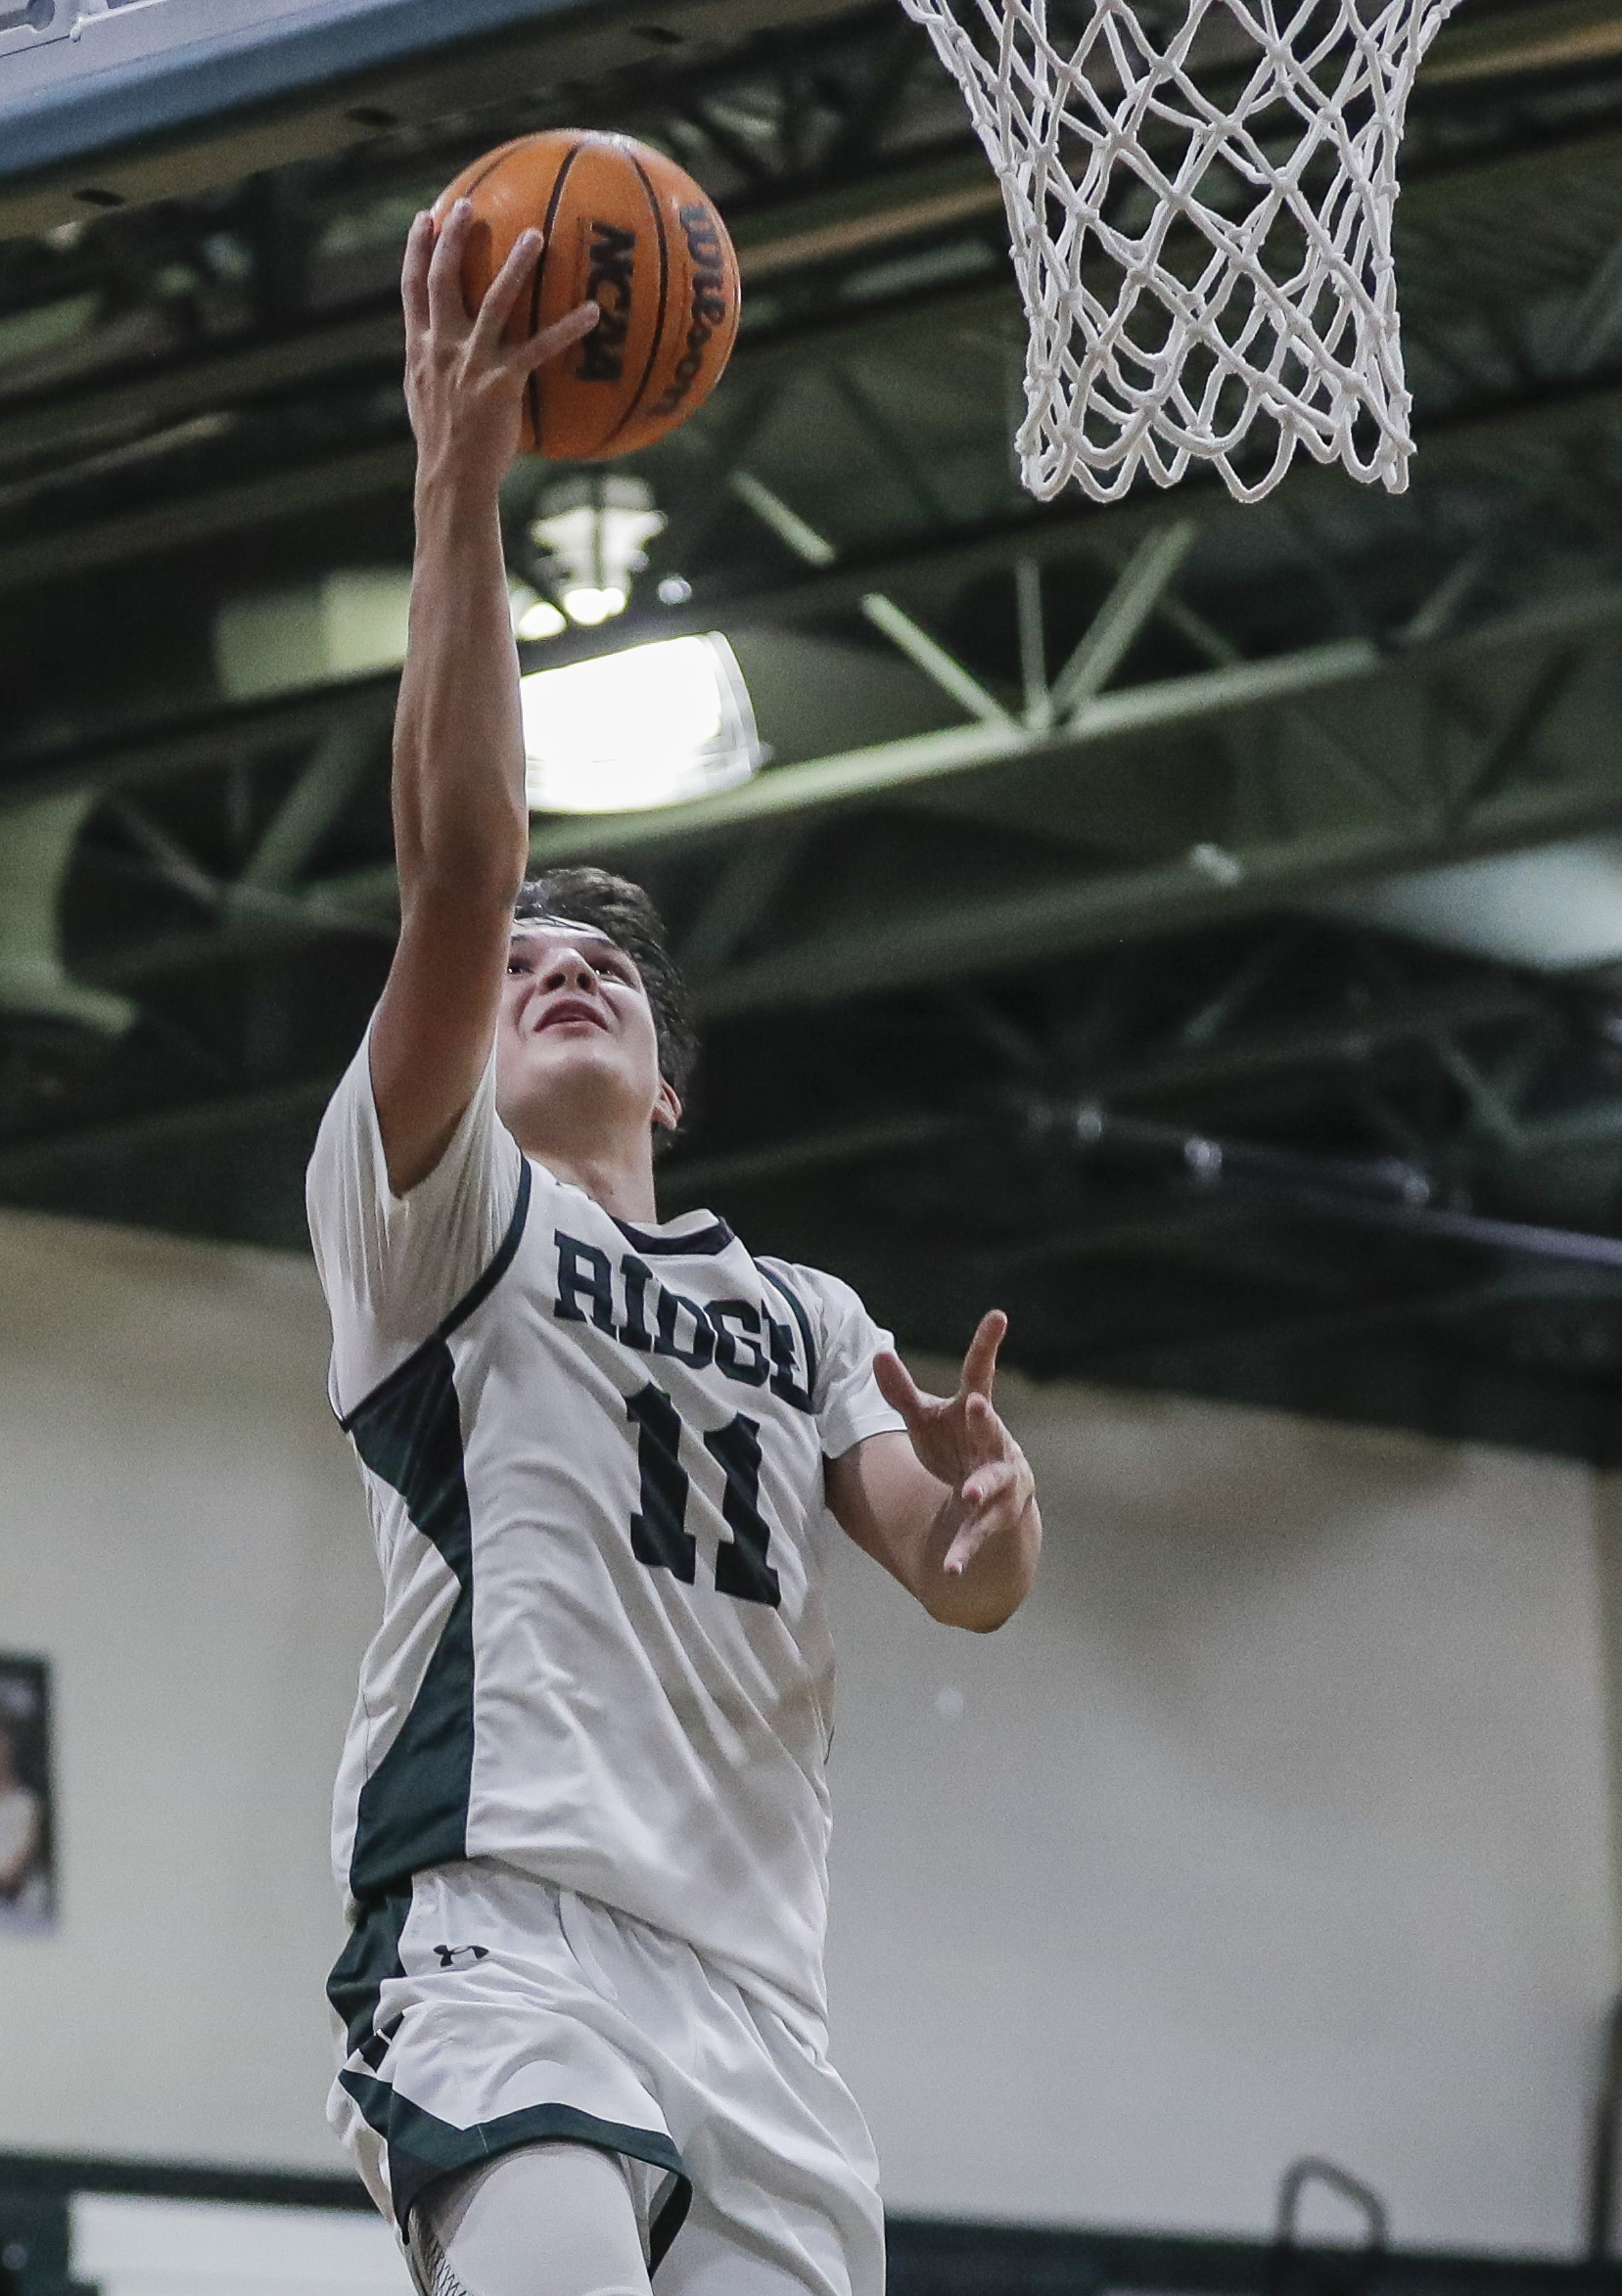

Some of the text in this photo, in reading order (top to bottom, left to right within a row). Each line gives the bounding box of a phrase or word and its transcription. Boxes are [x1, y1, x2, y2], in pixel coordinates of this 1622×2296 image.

[576, 221, 636, 382] NCAA
[554, 1228, 812, 1415] RIDGE
[626, 1382, 781, 1609] 11
